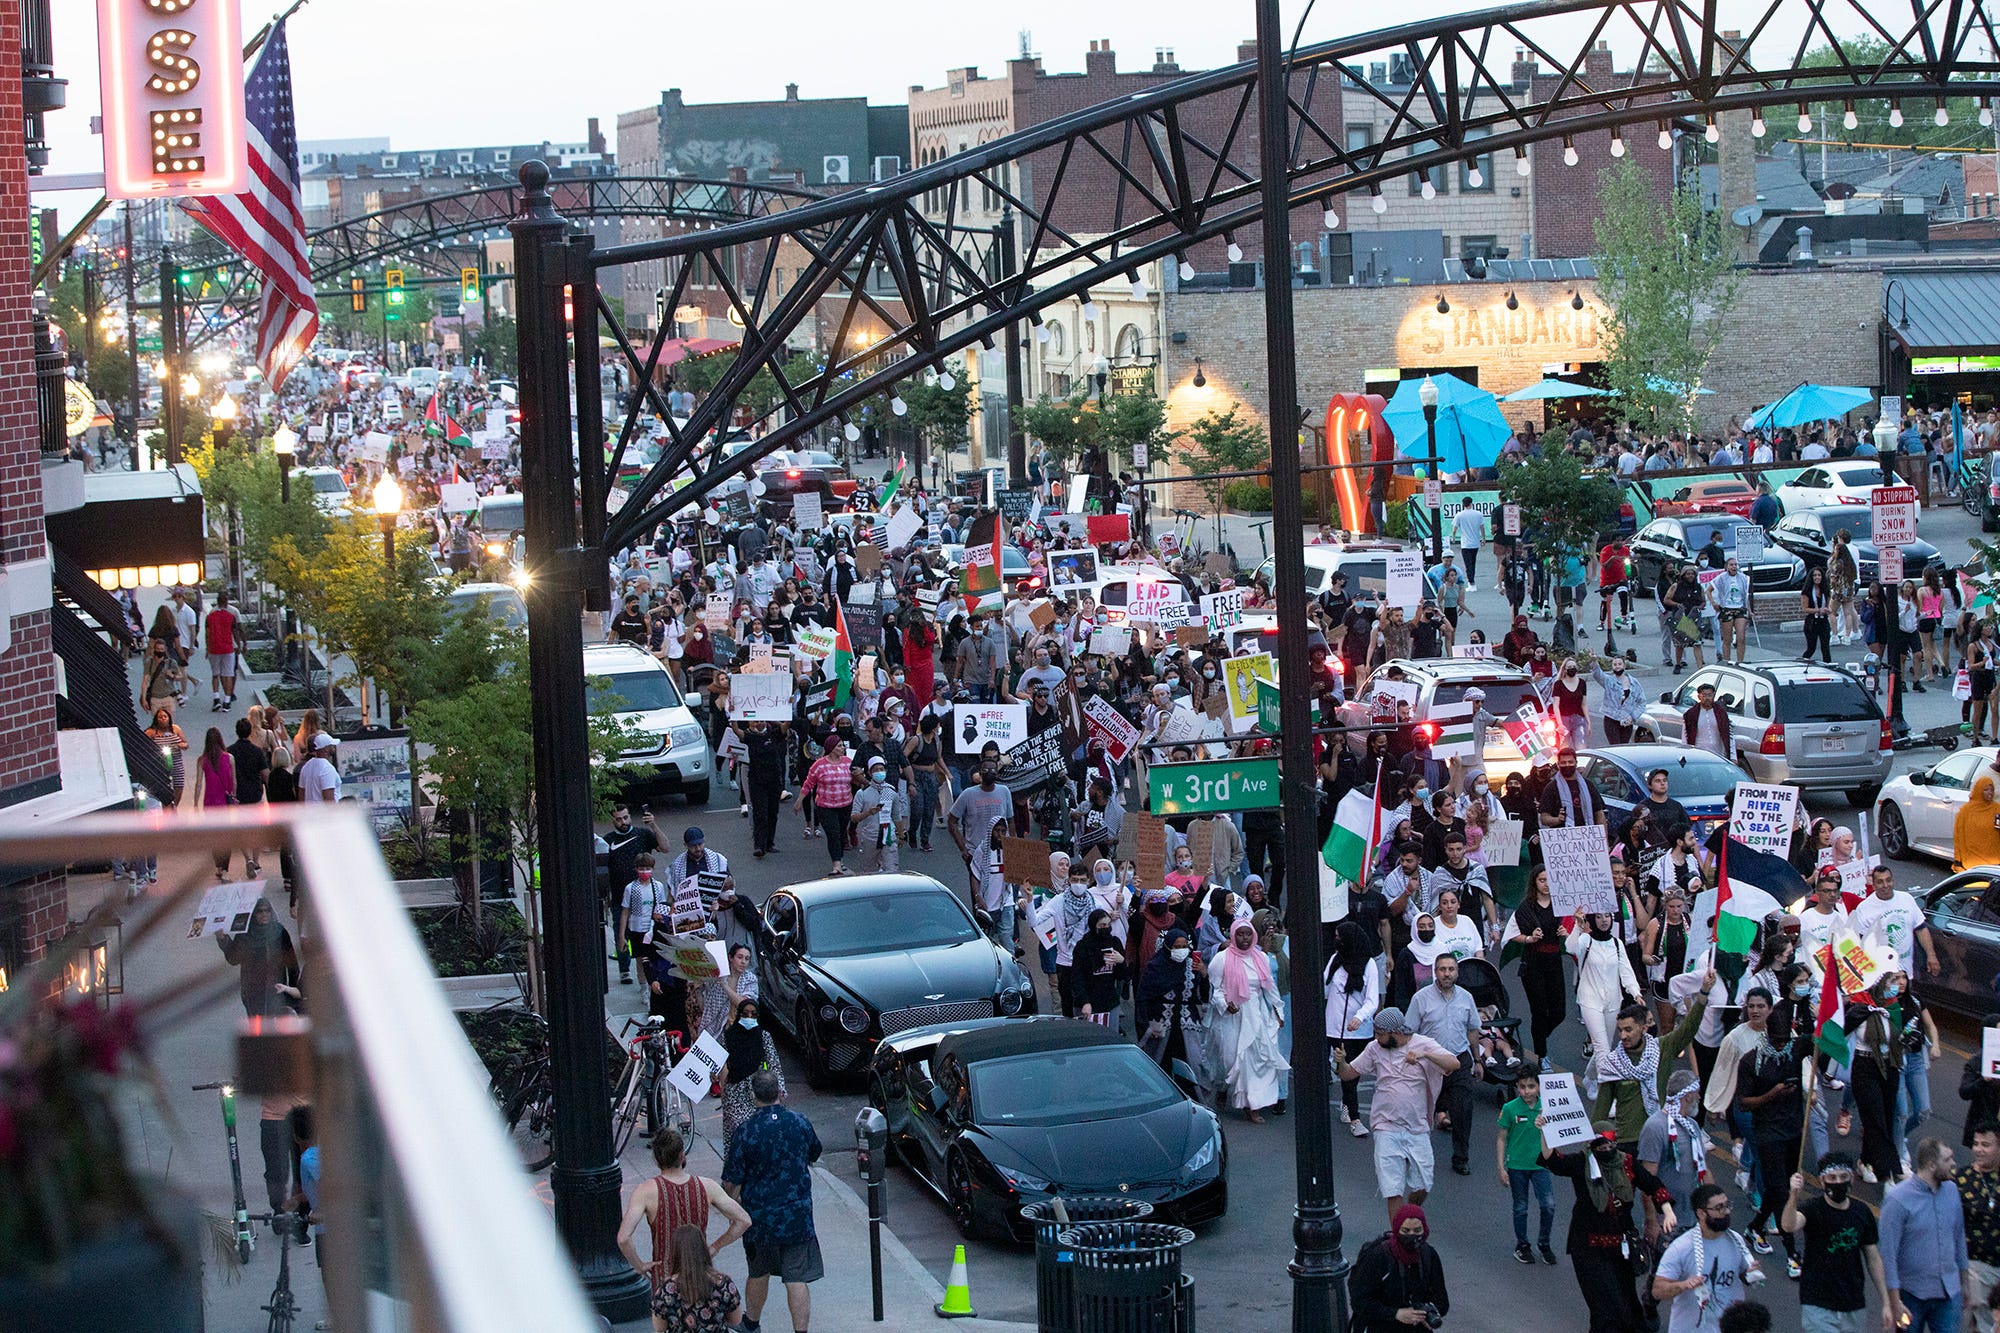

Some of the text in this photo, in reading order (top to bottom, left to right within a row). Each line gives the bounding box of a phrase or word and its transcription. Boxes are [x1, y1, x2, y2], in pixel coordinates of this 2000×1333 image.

[1421, 305, 1598, 354] STANDARD
[1112, 367, 1154, 379] STANDARD
[1873, 489, 1913, 503] NO STOPPING
[855, 497, 869, 511] 52
[1880, 506, 1906, 516] DURING
[1882, 518, 1906, 530] SNOW
[1874, 531, 1913, 543] EMERGENCY
[709, 594, 729, 602] Tax
[1136, 582, 1170, 601] END
[1213, 593, 1241, 614] FREE
[1159, 604, 1187, 620] FREE
[1161, 617, 1190, 630] PALESTINE
[1203, 610, 1243, 632] PALESTINE
[751, 645, 768, 657] Free
[798, 642, 830, 659] PALESTINE
[1226, 661, 1236, 671] ALL
[1236, 659, 1249, 670] EYES
[980, 710, 1004, 720] #FREE
[985, 721, 1012, 730] SHEIKH
[1096, 712, 1129, 743] CHILDREN
[1110, 711, 1132, 734] KILLING
[984, 730, 1010, 739] JARRAH
[1010, 723, 1063, 760] FROM THE RIVER
[1014, 757, 1023, 767] TO
[1029, 745, 1042, 758] THE
[1162, 773, 1267, 803] W 3rd Ave
[1739, 788, 1793, 801] FROM THE
[1747, 801, 1781, 812] RIVER
[1740, 811, 1783, 823] TO THE
[1541, 827, 1606, 843] DEAR ISRAEL
[1749, 823, 1771, 833] SEA
[1546, 840, 1605, 856] YOU CAN NOT
[1548, 853, 1599, 869] BREAK AN
[1549, 869, 1588, 884] UMMAH
[1558, 881, 1599, 895] ALLAH
[1551, 892, 1609, 907] THEY FEAR
[675, 901, 700, 915] SRAEL
[1846, 946, 1876, 977] FREE
[690, 1044, 721, 1075] PALESTINE
[684, 1068, 703, 1086] FREE
[1545, 1080, 1568, 1090] ISRAEL
[1548, 1097, 1570, 1107] IS AN
[1558, 1126, 1582, 1138] STATE
[1717, 1271, 1734, 1286] 48
